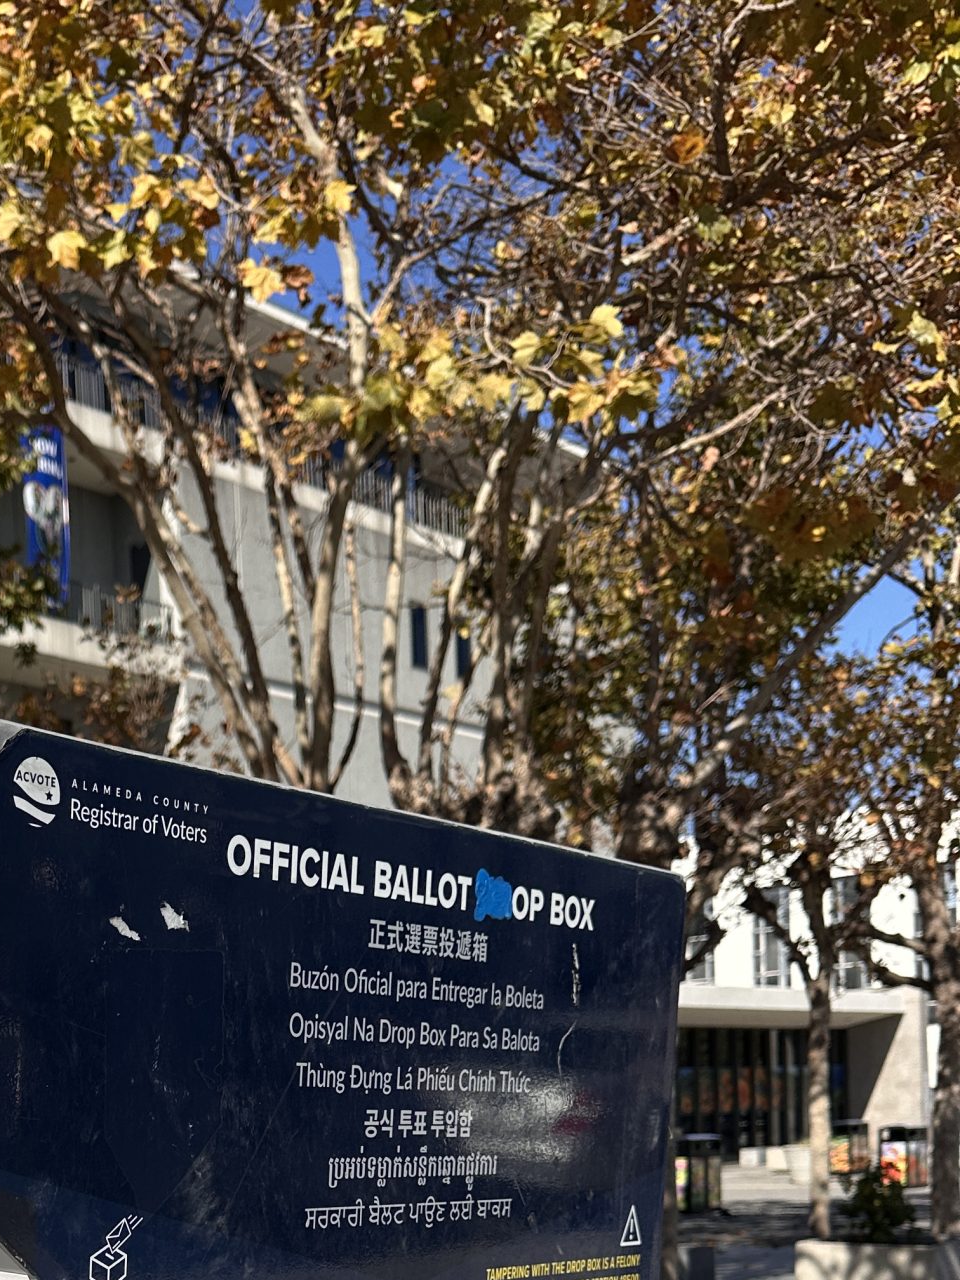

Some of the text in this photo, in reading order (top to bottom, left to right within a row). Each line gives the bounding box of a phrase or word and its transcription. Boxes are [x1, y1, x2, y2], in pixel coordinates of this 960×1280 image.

[15, 767, 57, 790] ACVOTE
[71, 778, 208, 814] ALAMEDA COUNTY
[70, 798, 207, 843] Registrar of Voters
[227, 835, 364, 894] OFFICIAL
[373, 860, 472, 910] BALLOT
[549, 892, 595, 931] BOX
[369, 919, 487, 962] 正式選票投遞箱
[289, 961, 544, 1009] Buzón Oficial para Entregar la Boleta
[289, 1012, 540, 1052] Opisyal Na Drop Box Para Sa Balota
[296, 1061, 531, 1098] Thùng Đựng Lá Phiếu Chính Thức
[364, 1108, 474, 1138] 공식 투표 투입함
[486, 1254, 640, 1280] TAMPERING WITH THE DROP BOX IS A FELONY
